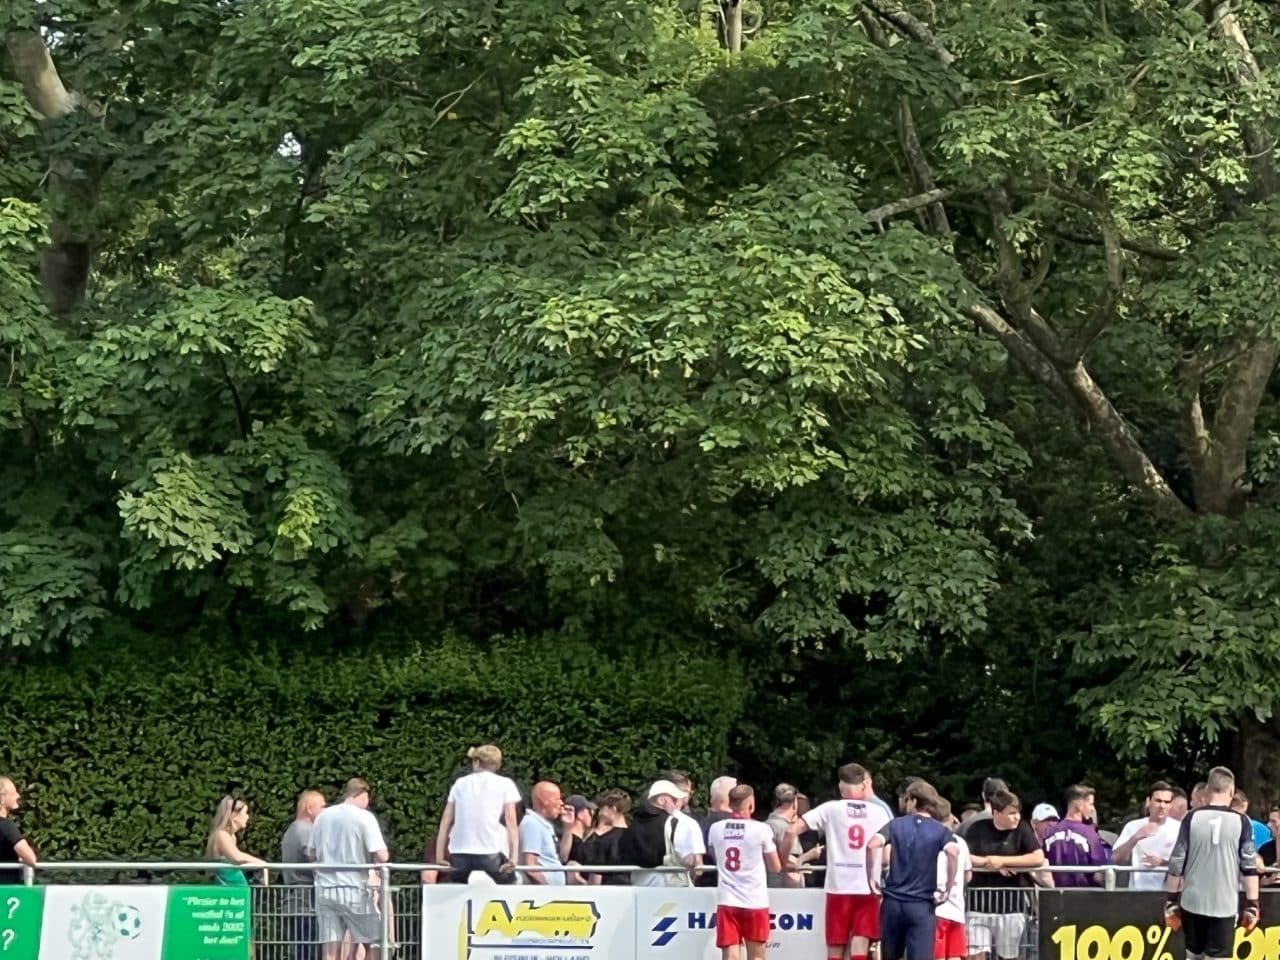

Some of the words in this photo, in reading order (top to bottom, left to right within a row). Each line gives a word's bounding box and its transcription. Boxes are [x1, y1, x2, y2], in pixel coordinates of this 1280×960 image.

[847, 824, 865, 849] 9
[1208, 816, 1222, 845] 1
[725, 847, 741, 872] 8
[687, 912, 814, 931] HCON
